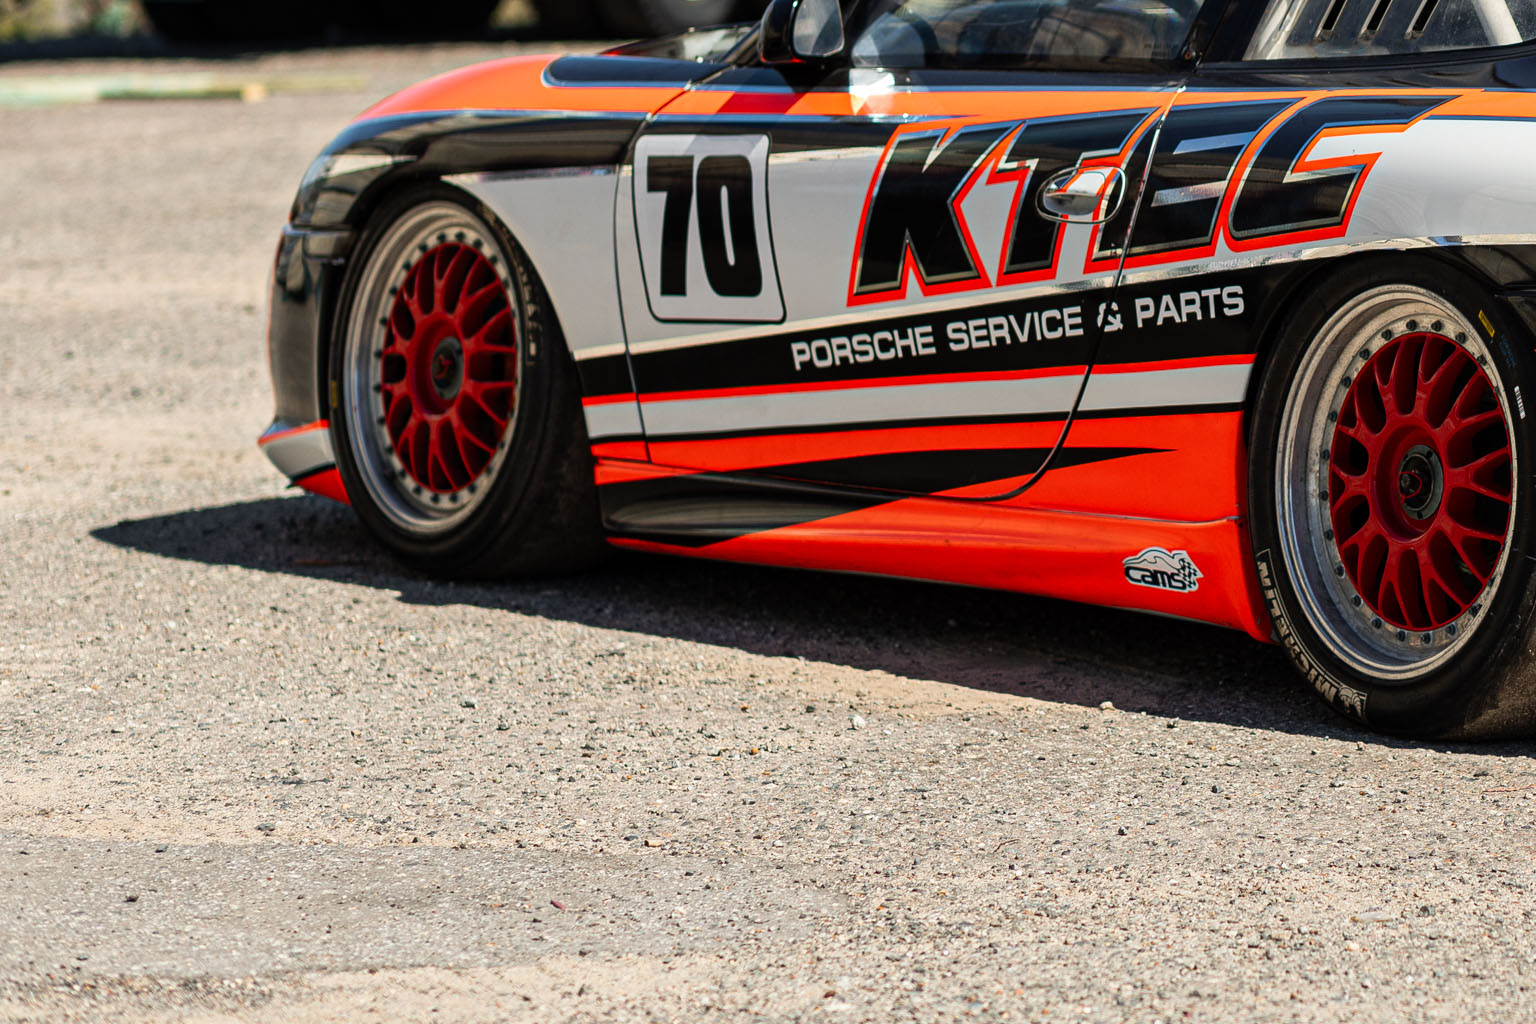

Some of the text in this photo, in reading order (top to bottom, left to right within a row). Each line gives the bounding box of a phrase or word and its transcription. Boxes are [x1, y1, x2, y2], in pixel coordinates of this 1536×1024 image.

[647, 155, 762, 297] 70
[791, 286, 1245, 370] PORSCHE SERVICE & PARTS
[1257, 561, 1338, 703] MICHELIN
